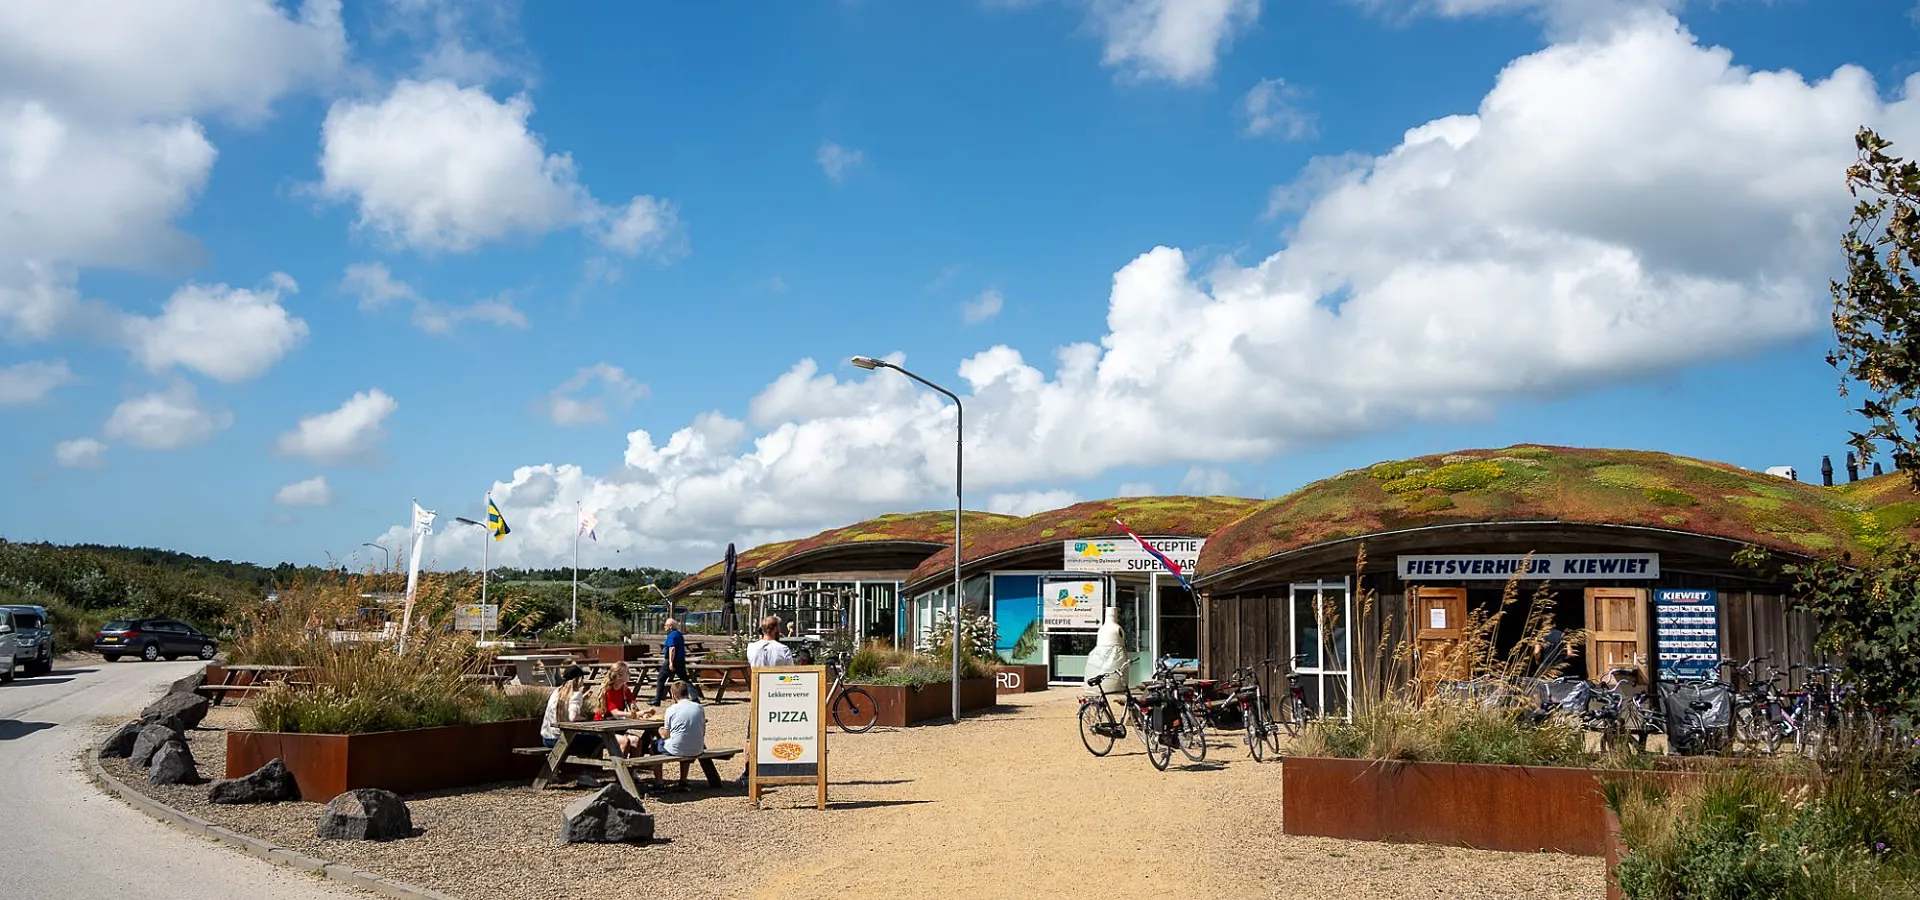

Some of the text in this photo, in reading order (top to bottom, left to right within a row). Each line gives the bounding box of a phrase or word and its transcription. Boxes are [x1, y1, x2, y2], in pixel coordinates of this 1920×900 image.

[1142, 541, 1197, 552] ECEPTIE
[1128, 559, 1196, 570] SUPEAR
[1407, 558, 1650, 574] FIETSVERHUUR KIEWIET
[1663, 591, 1706, 600] KIEWIET
[996, 672, 1020, 688] RD
[768, 711, 808, 722] PIZZA
